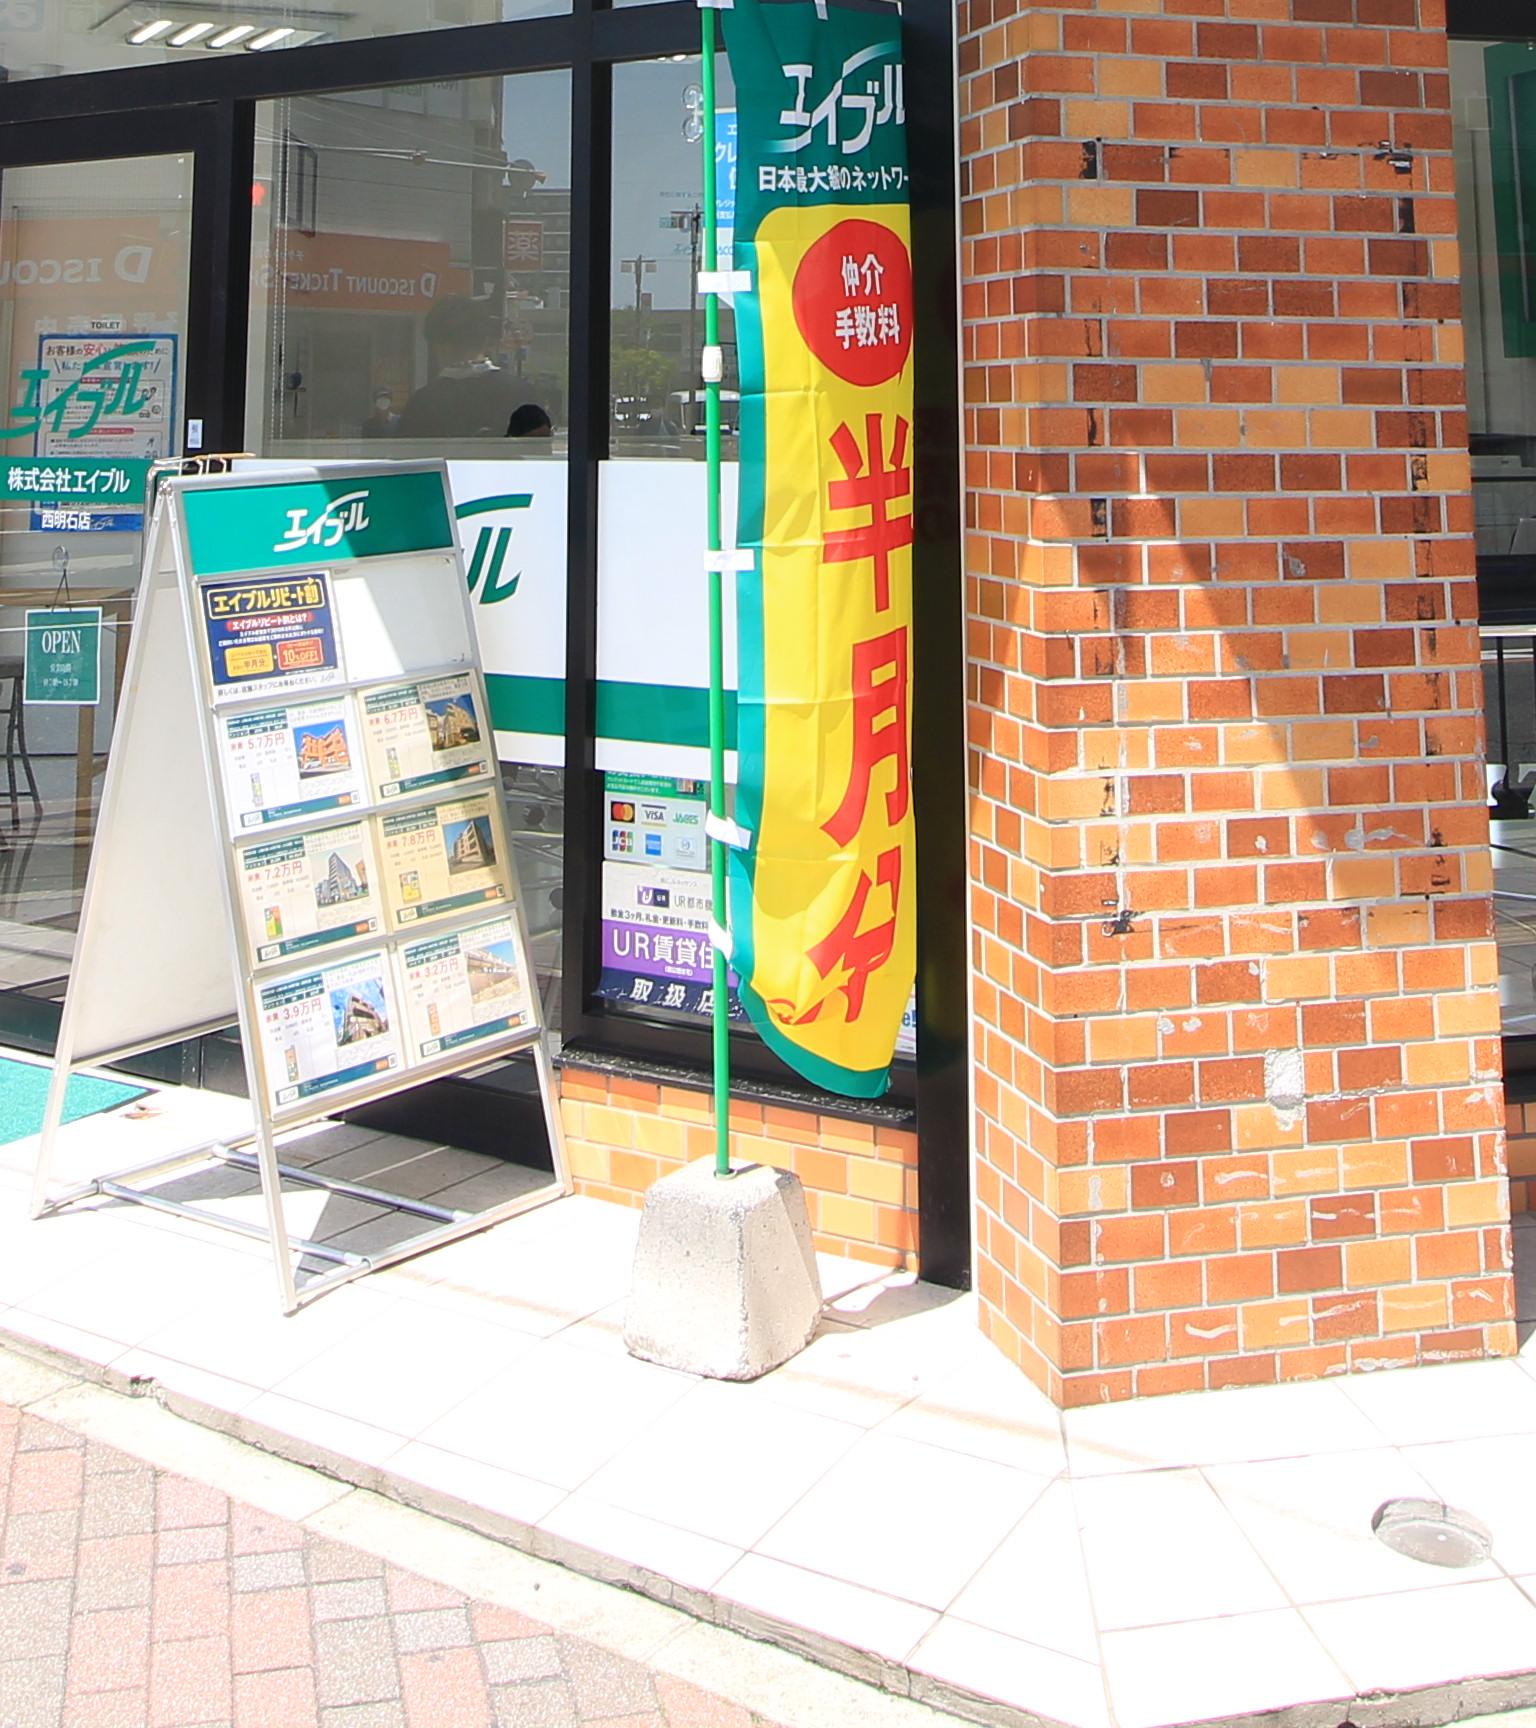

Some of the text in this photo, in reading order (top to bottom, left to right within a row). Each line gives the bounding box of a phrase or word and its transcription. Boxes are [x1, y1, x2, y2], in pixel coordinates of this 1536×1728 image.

[758, 41, 906, 154] エイブル
[841, 253, 884, 297] 仲介
[90, 321, 120, 329] TOILET
[835, 303, 901, 350] 手数料
[7, 466, 130, 494] 株式会社エイブル
[41, 510, 92, 530] 西明石店
[272, 490, 370, 553] エイブル
[213, 584, 320, 613] エイブルリピート割
[41, 630, 82, 654] OPEN
[644, 809, 665, 821] VISA
